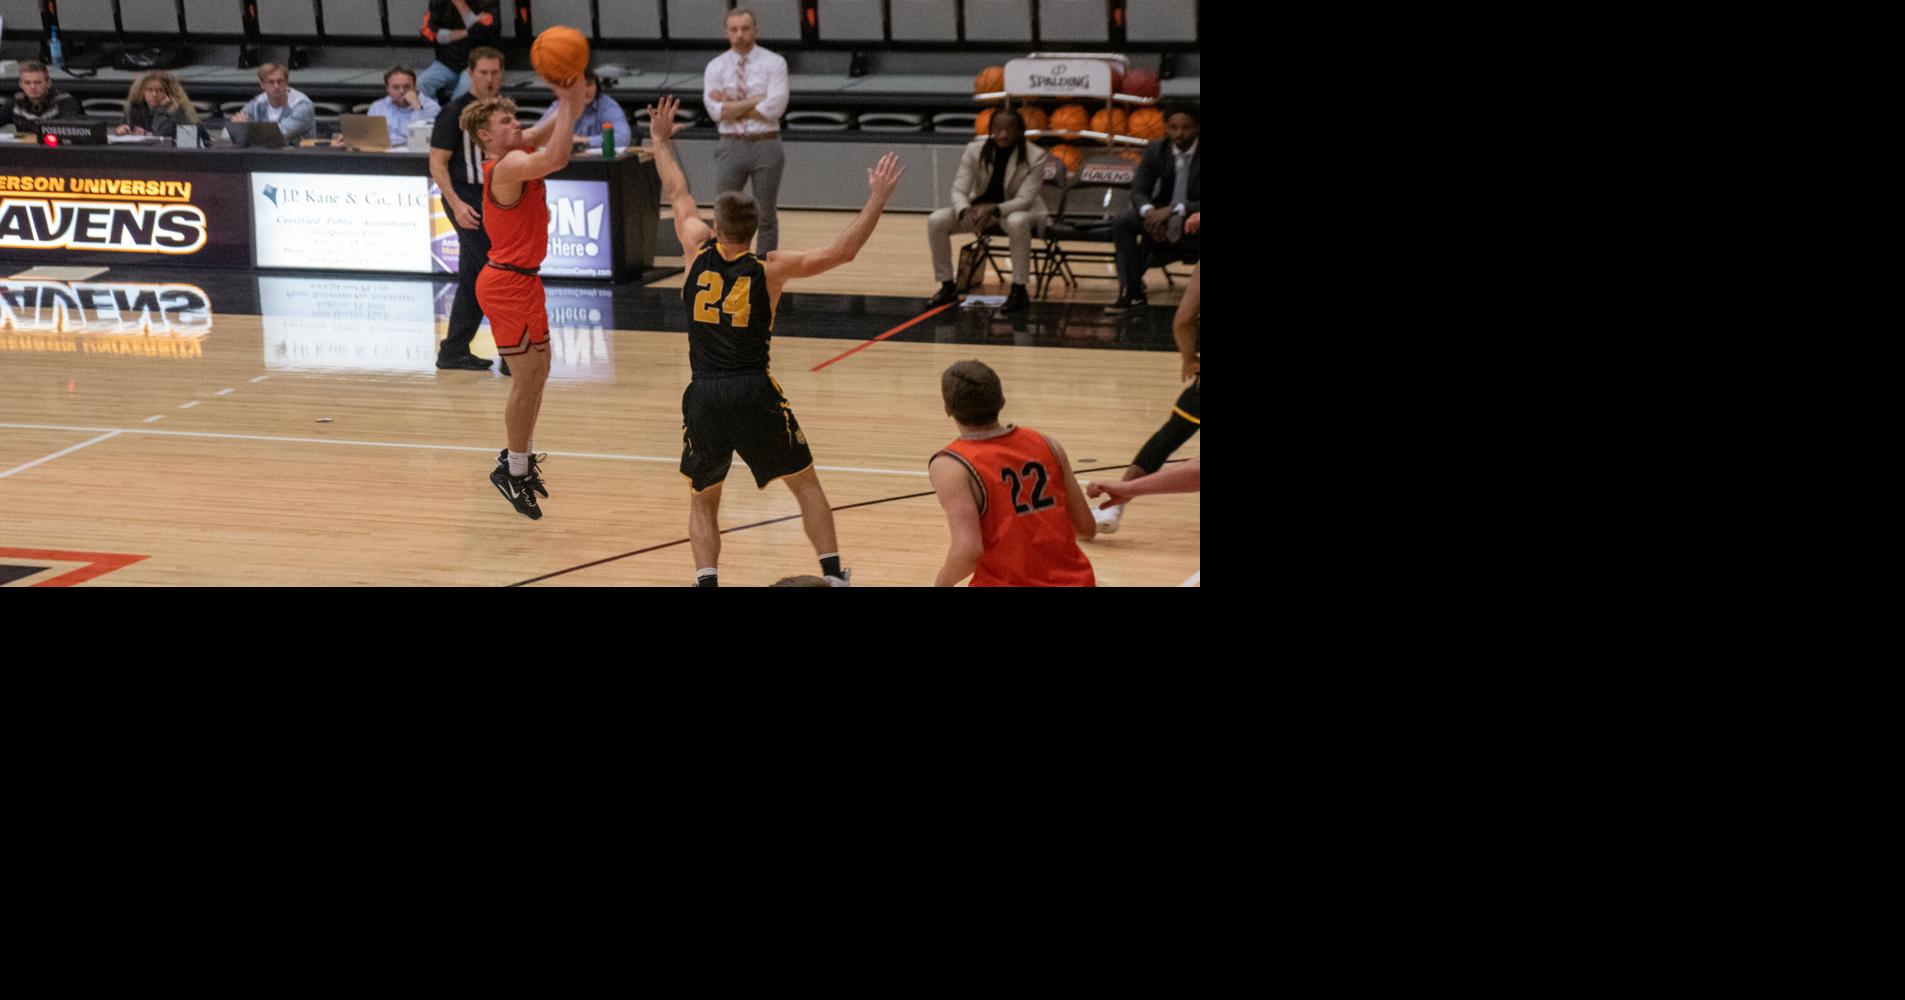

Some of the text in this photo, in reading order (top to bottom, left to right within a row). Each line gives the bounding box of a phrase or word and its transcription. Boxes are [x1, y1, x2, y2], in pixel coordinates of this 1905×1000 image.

[1029, 74, 1090, 89] SPALDING
[41, 126, 92, 136] POSSESSION
[70, 178, 192, 199] UNIVERSITY
[305, 189, 340, 204] Kane
[345, 191, 358, 205] &
[0, 203, 203, 249] AVENS
[552, 237, 584, 257] Here
[693, 269, 752, 328] 24
[1001, 460, 1056, 516] 22
